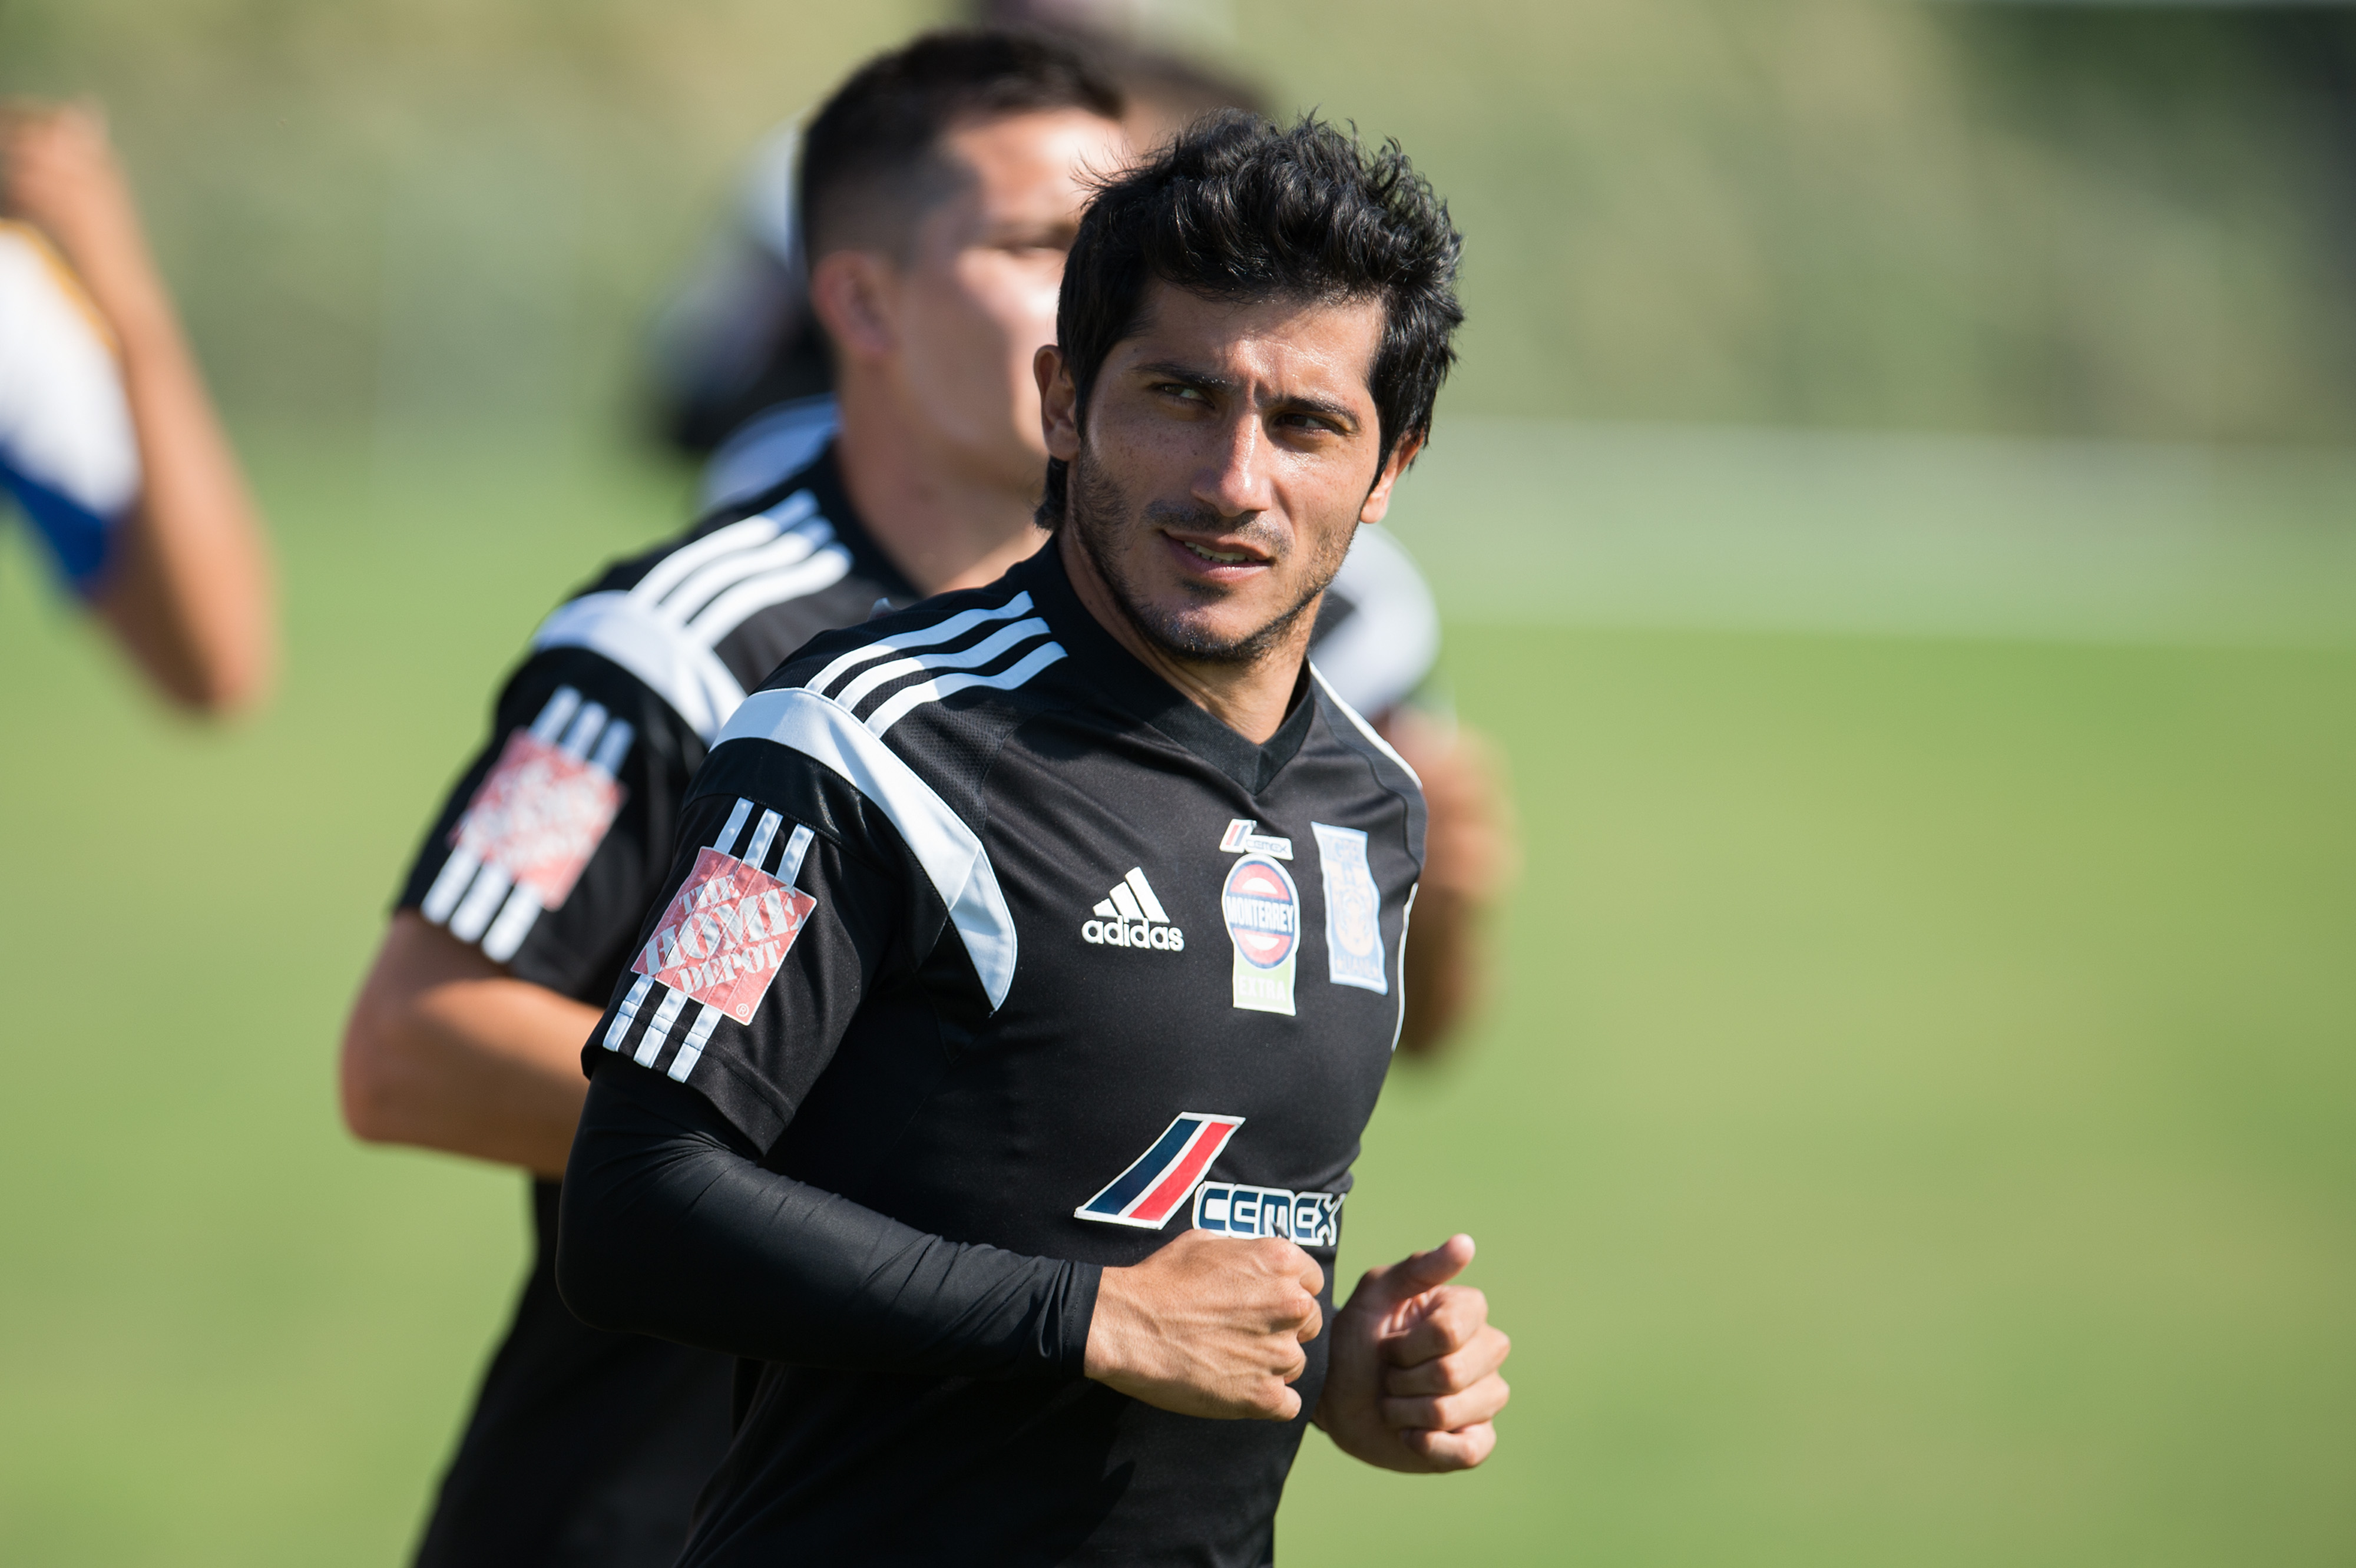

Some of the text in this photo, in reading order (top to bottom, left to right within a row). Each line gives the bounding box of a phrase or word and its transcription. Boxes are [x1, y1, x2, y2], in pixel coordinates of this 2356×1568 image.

[1246, 839, 1288, 853] CEMEX
[679, 874, 741, 916] THE
[1226, 895, 1293, 933] MONTERREY
[646, 885, 803, 977] HOME
[1081, 915, 1184, 952] adidas
[677, 940, 782, 994] DEPOT
[1238, 975, 1286, 1001] EXTRA
[1196, 1185, 1346, 1243] CEMEX
